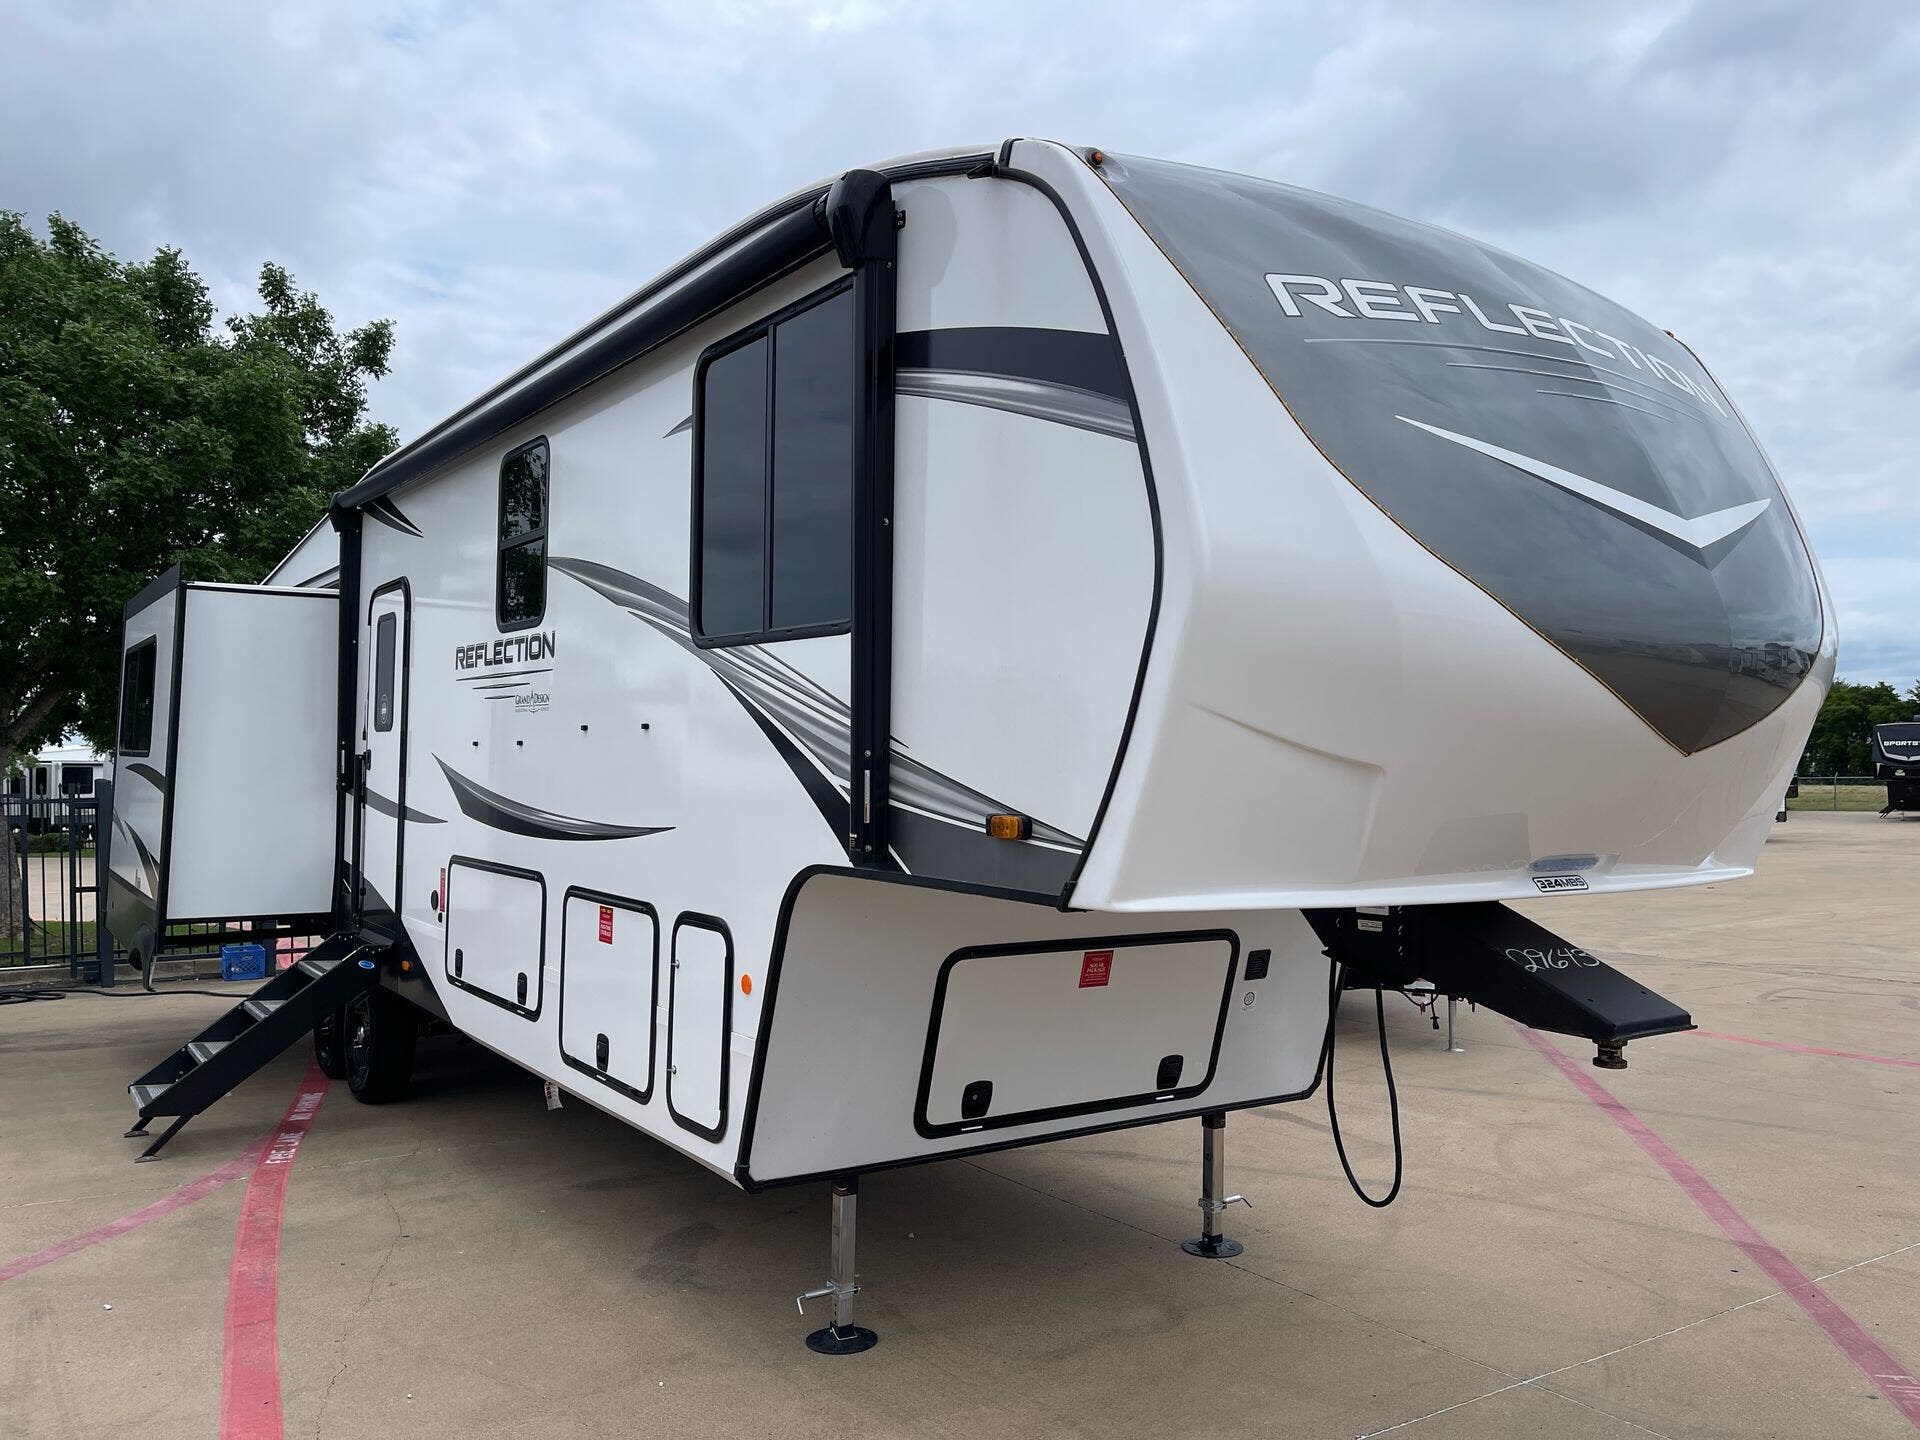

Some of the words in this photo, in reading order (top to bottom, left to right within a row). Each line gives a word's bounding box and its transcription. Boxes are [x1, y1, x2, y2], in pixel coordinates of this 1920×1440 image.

[1264, 272, 1728, 418] REFLECTION
[455, 630, 556, 670] REFLECTION
[515, 694, 530, 704] GRAND
[533, 692, 550, 703] DESIGN
[1537, 879, 1585, 889] 324MBS
